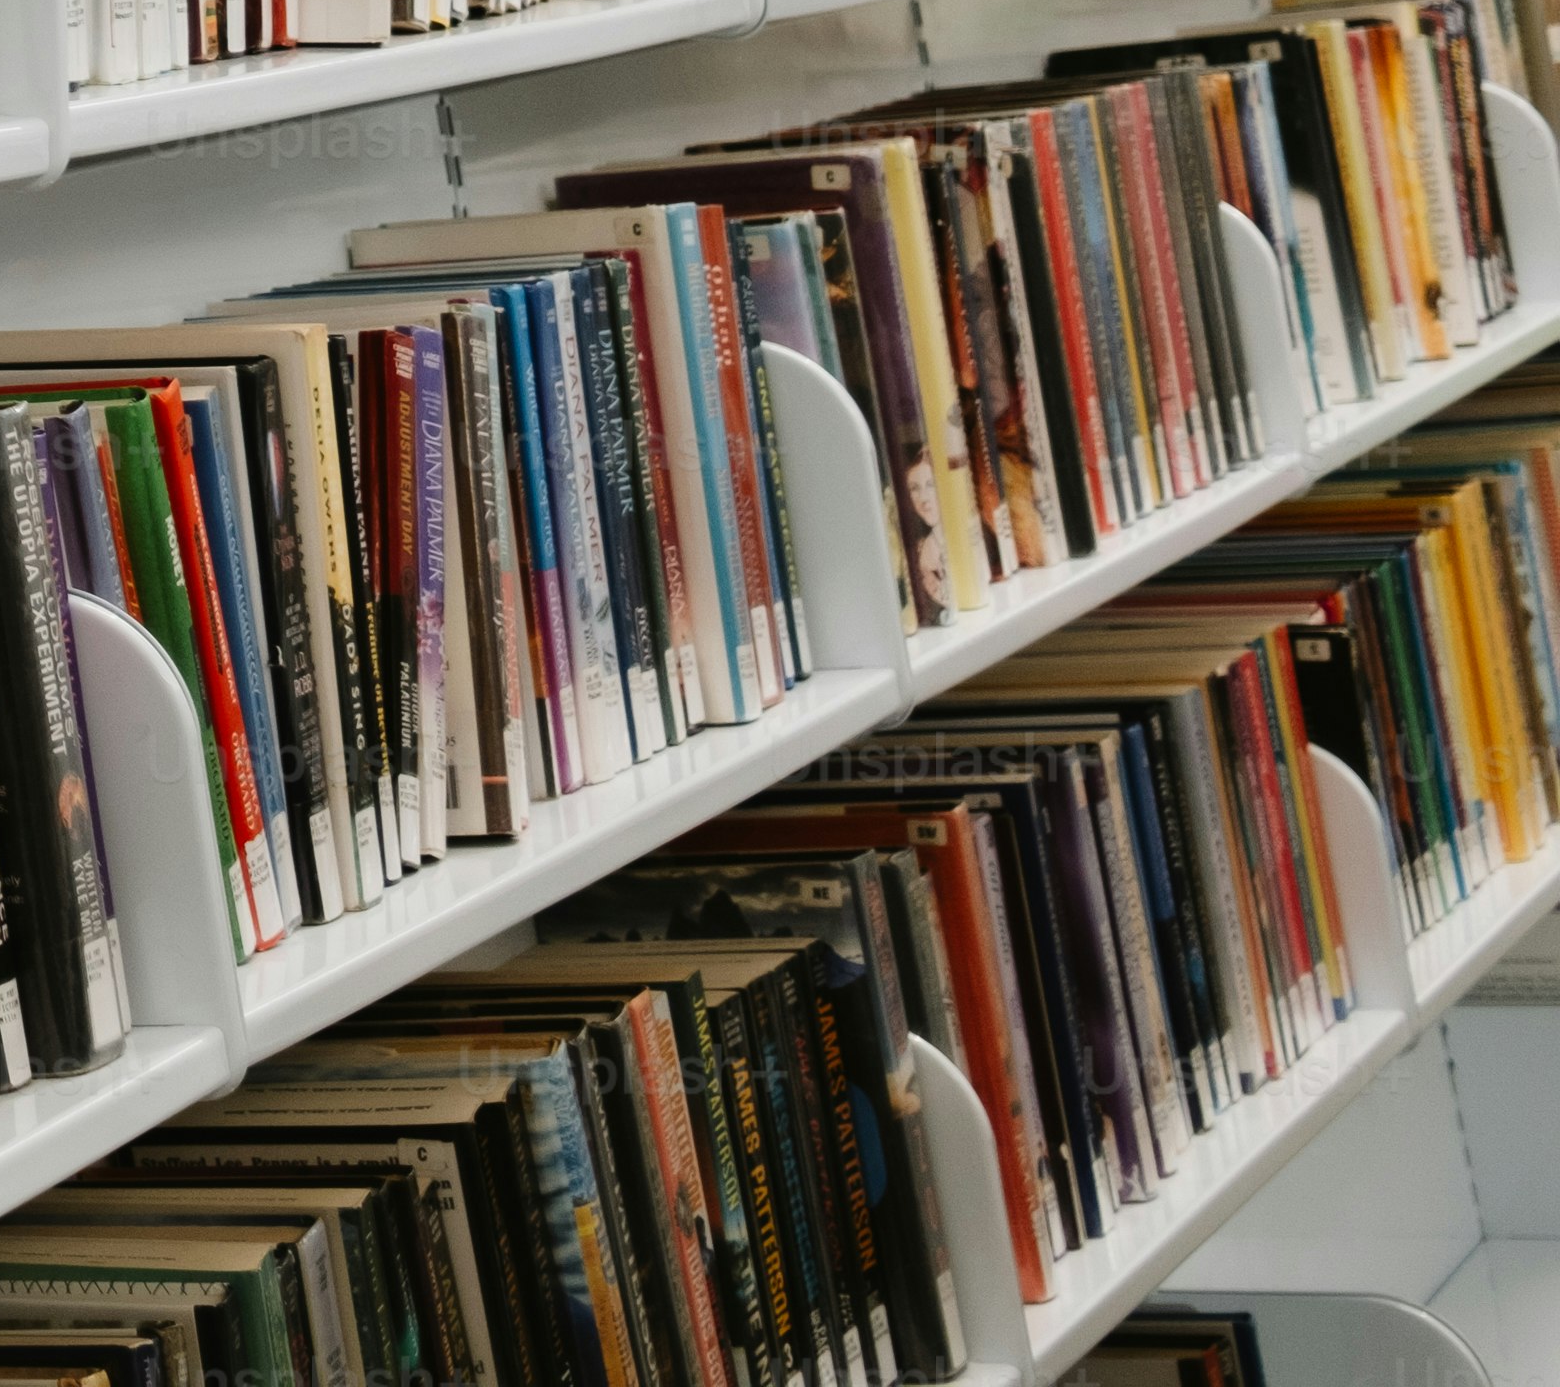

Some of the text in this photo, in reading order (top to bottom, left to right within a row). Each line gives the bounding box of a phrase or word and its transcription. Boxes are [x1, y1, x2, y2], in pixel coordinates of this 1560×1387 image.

[396, 390, 414, 557] ADJUSTMENT DAY
[420, 412, 445, 583] DIANA PALMER
[563, 334, 605, 585] DIANA PALMER
[4, 427, 69, 757] THE UTOPIA EXPERIMENT
[20, 437, 75, 736] ROBERT LUDLUM'S
[399, 660, 411, 749] PALAHNIUK
[230, 730, 257, 831] ORCHARD
[690, 993, 742, 1215] JAMES PATTERSON
[730, 1055, 793, 1338] JAMES PATTERSON
[816, 995, 879, 1274] JAMES PATTERSON
